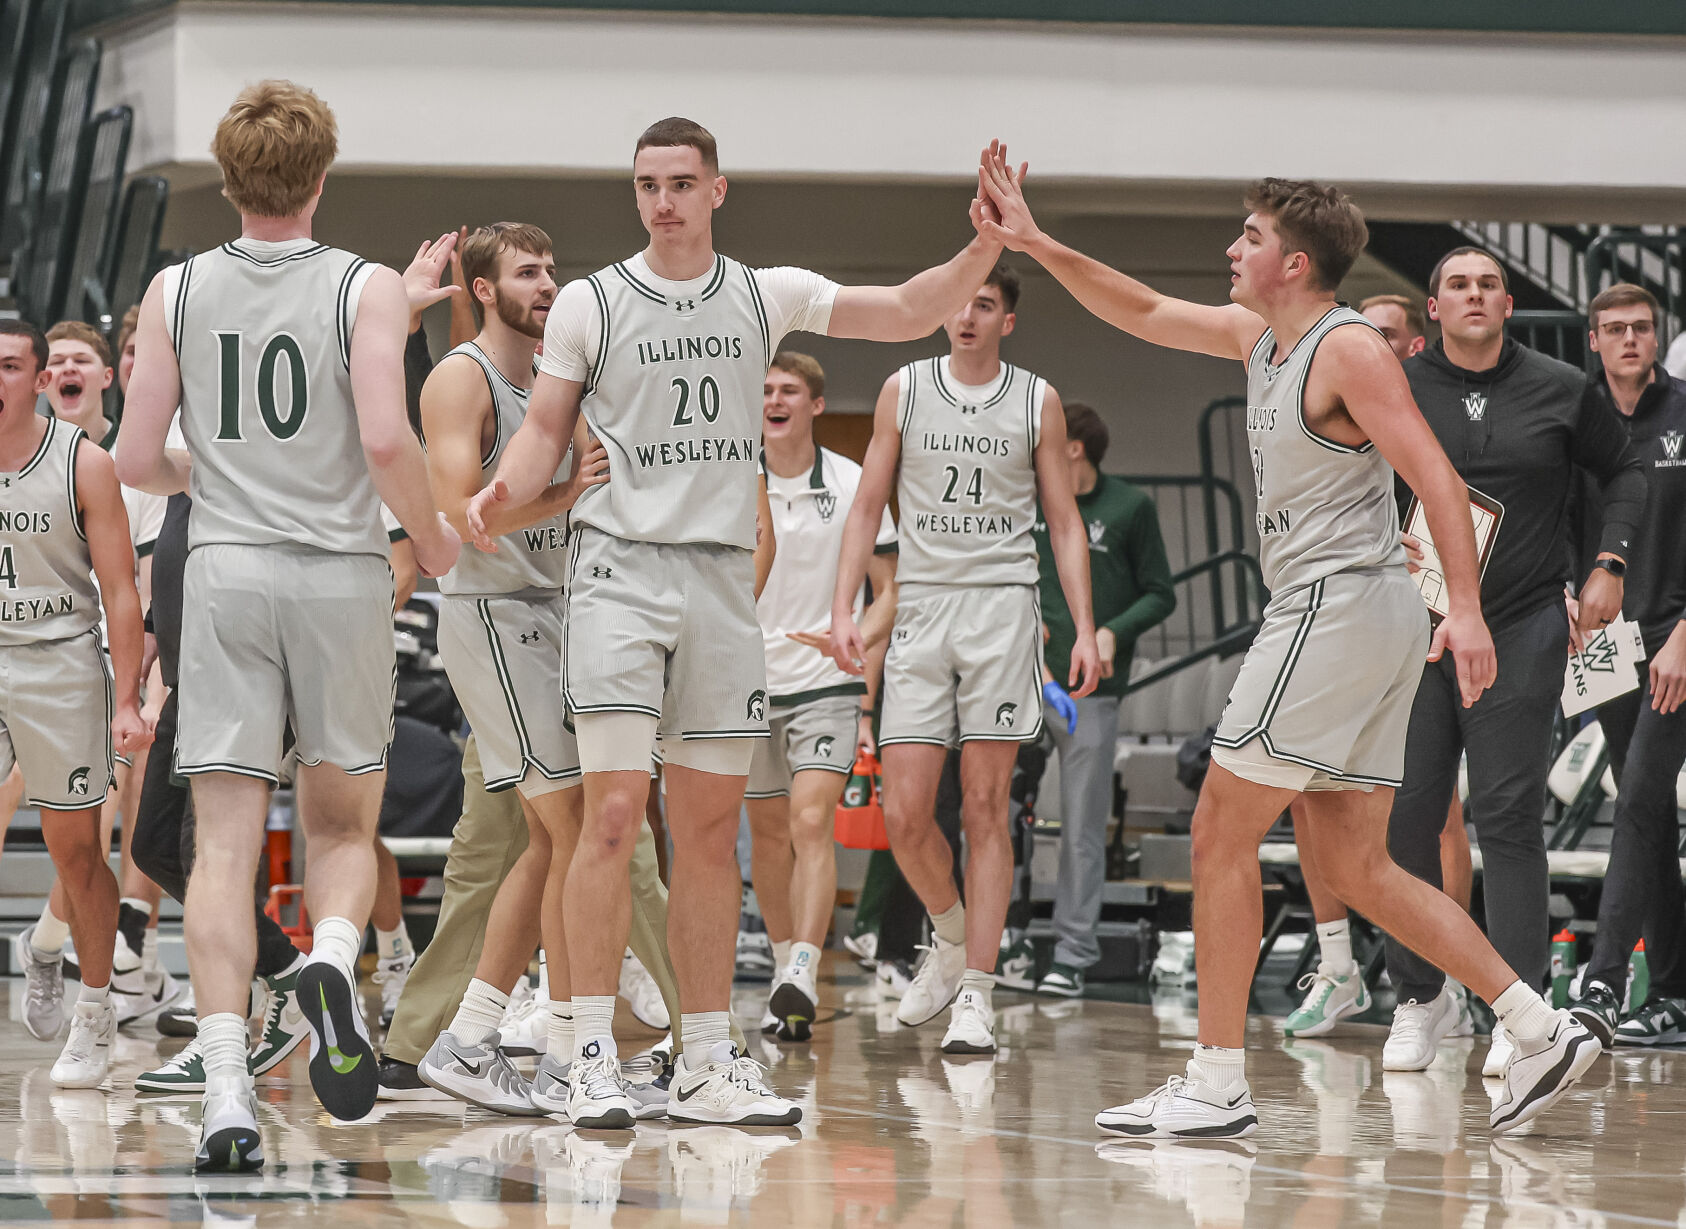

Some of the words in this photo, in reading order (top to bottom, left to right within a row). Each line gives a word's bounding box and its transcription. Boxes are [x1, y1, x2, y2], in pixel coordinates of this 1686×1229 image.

[637, 335, 742, 366] ILLINOIS
[210, 330, 310, 442] 10
[668, 373, 721, 429] 20
[634, 436, 754, 468] WESLEYAN
[922, 432, 1010, 457] ILLINOIS
[940, 463, 984, 506] 24
[0, 510, 52, 534] NOIS
[916, 512, 1013, 535] WESLEYAN
[0, 544, 19, 591] 4
[0, 593, 74, 622] LEYAN
